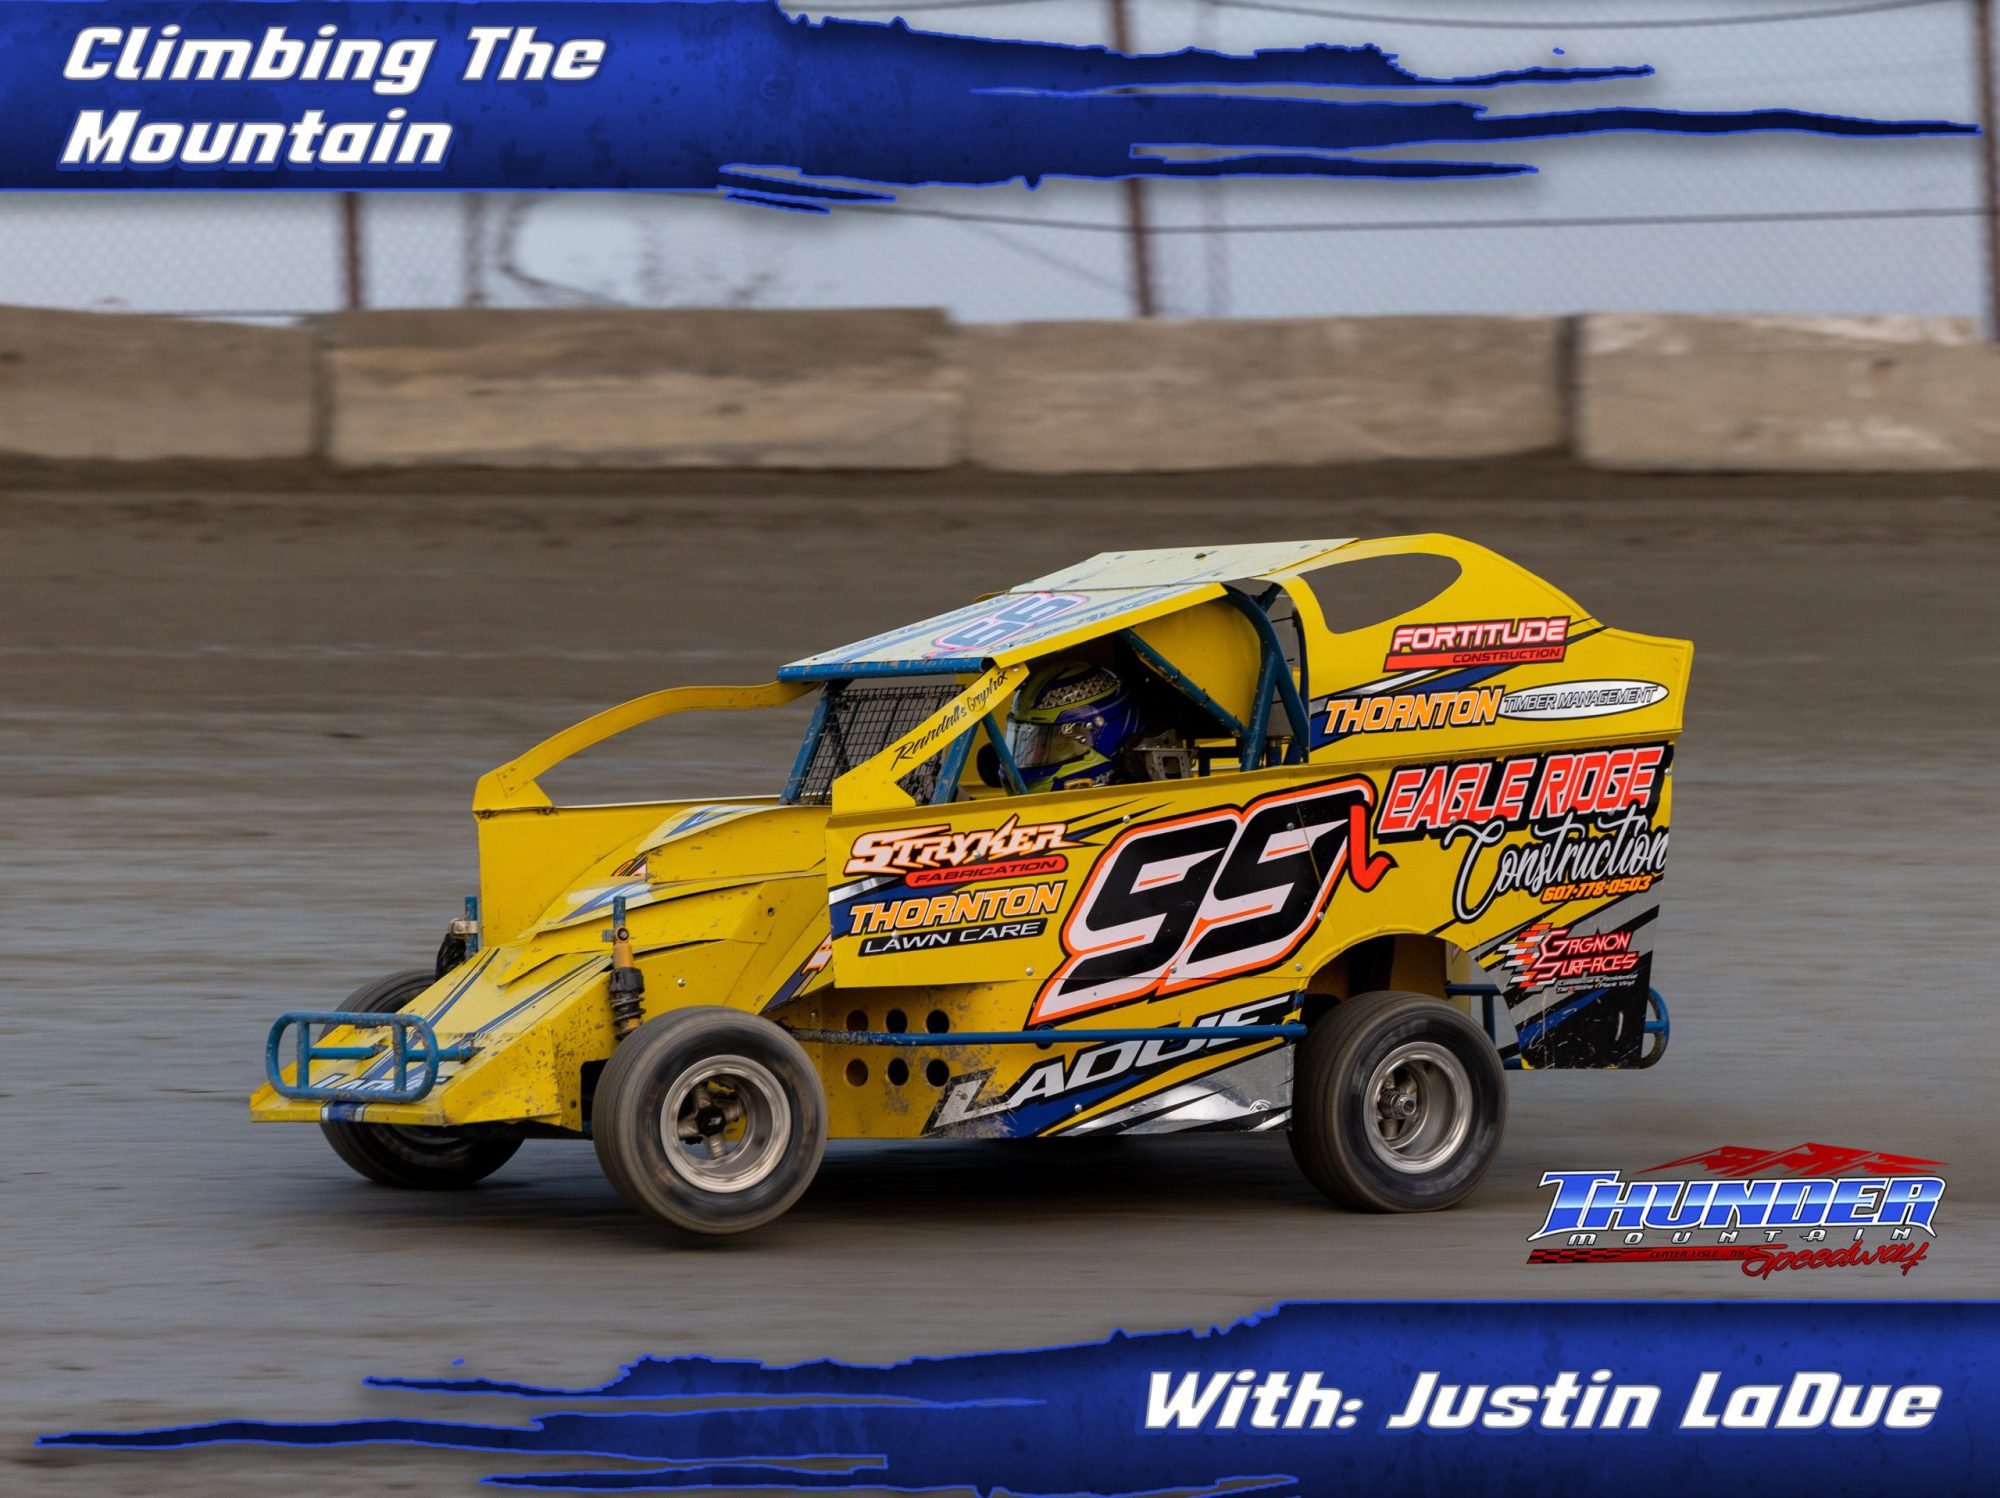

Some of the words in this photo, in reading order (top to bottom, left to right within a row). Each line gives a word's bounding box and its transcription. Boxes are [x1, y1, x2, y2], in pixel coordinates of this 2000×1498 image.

[1393, 618, 1567, 652] FORTITUDE
[1452, 647, 1561, 664] CONSTRUCTION
[1323, 688, 1503, 735] THORNTON
[1503, 693, 1558, 713] TIMBER
[1556, 686, 1658, 711] MANAGEMENT
[890, 705, 967, 771] Randall's
[1377, 757, 1538, 834] EAGLE
[1530, 746, 1665, 820] RIDGE
[844, 814, 1086, 875] STRYKER
[1444, 806, 1669, 921] Construction
[914, 859, 1059, 884] FABRICATION
[850, 882, 1065, 934] THORNTON
[864, 931, 956, 954] LAWN
[959, 921, 1041, 943] CARE
[1540, 929, 1632, 957] GAGNON
[1533, 952, 1638, 980] SURFACES
